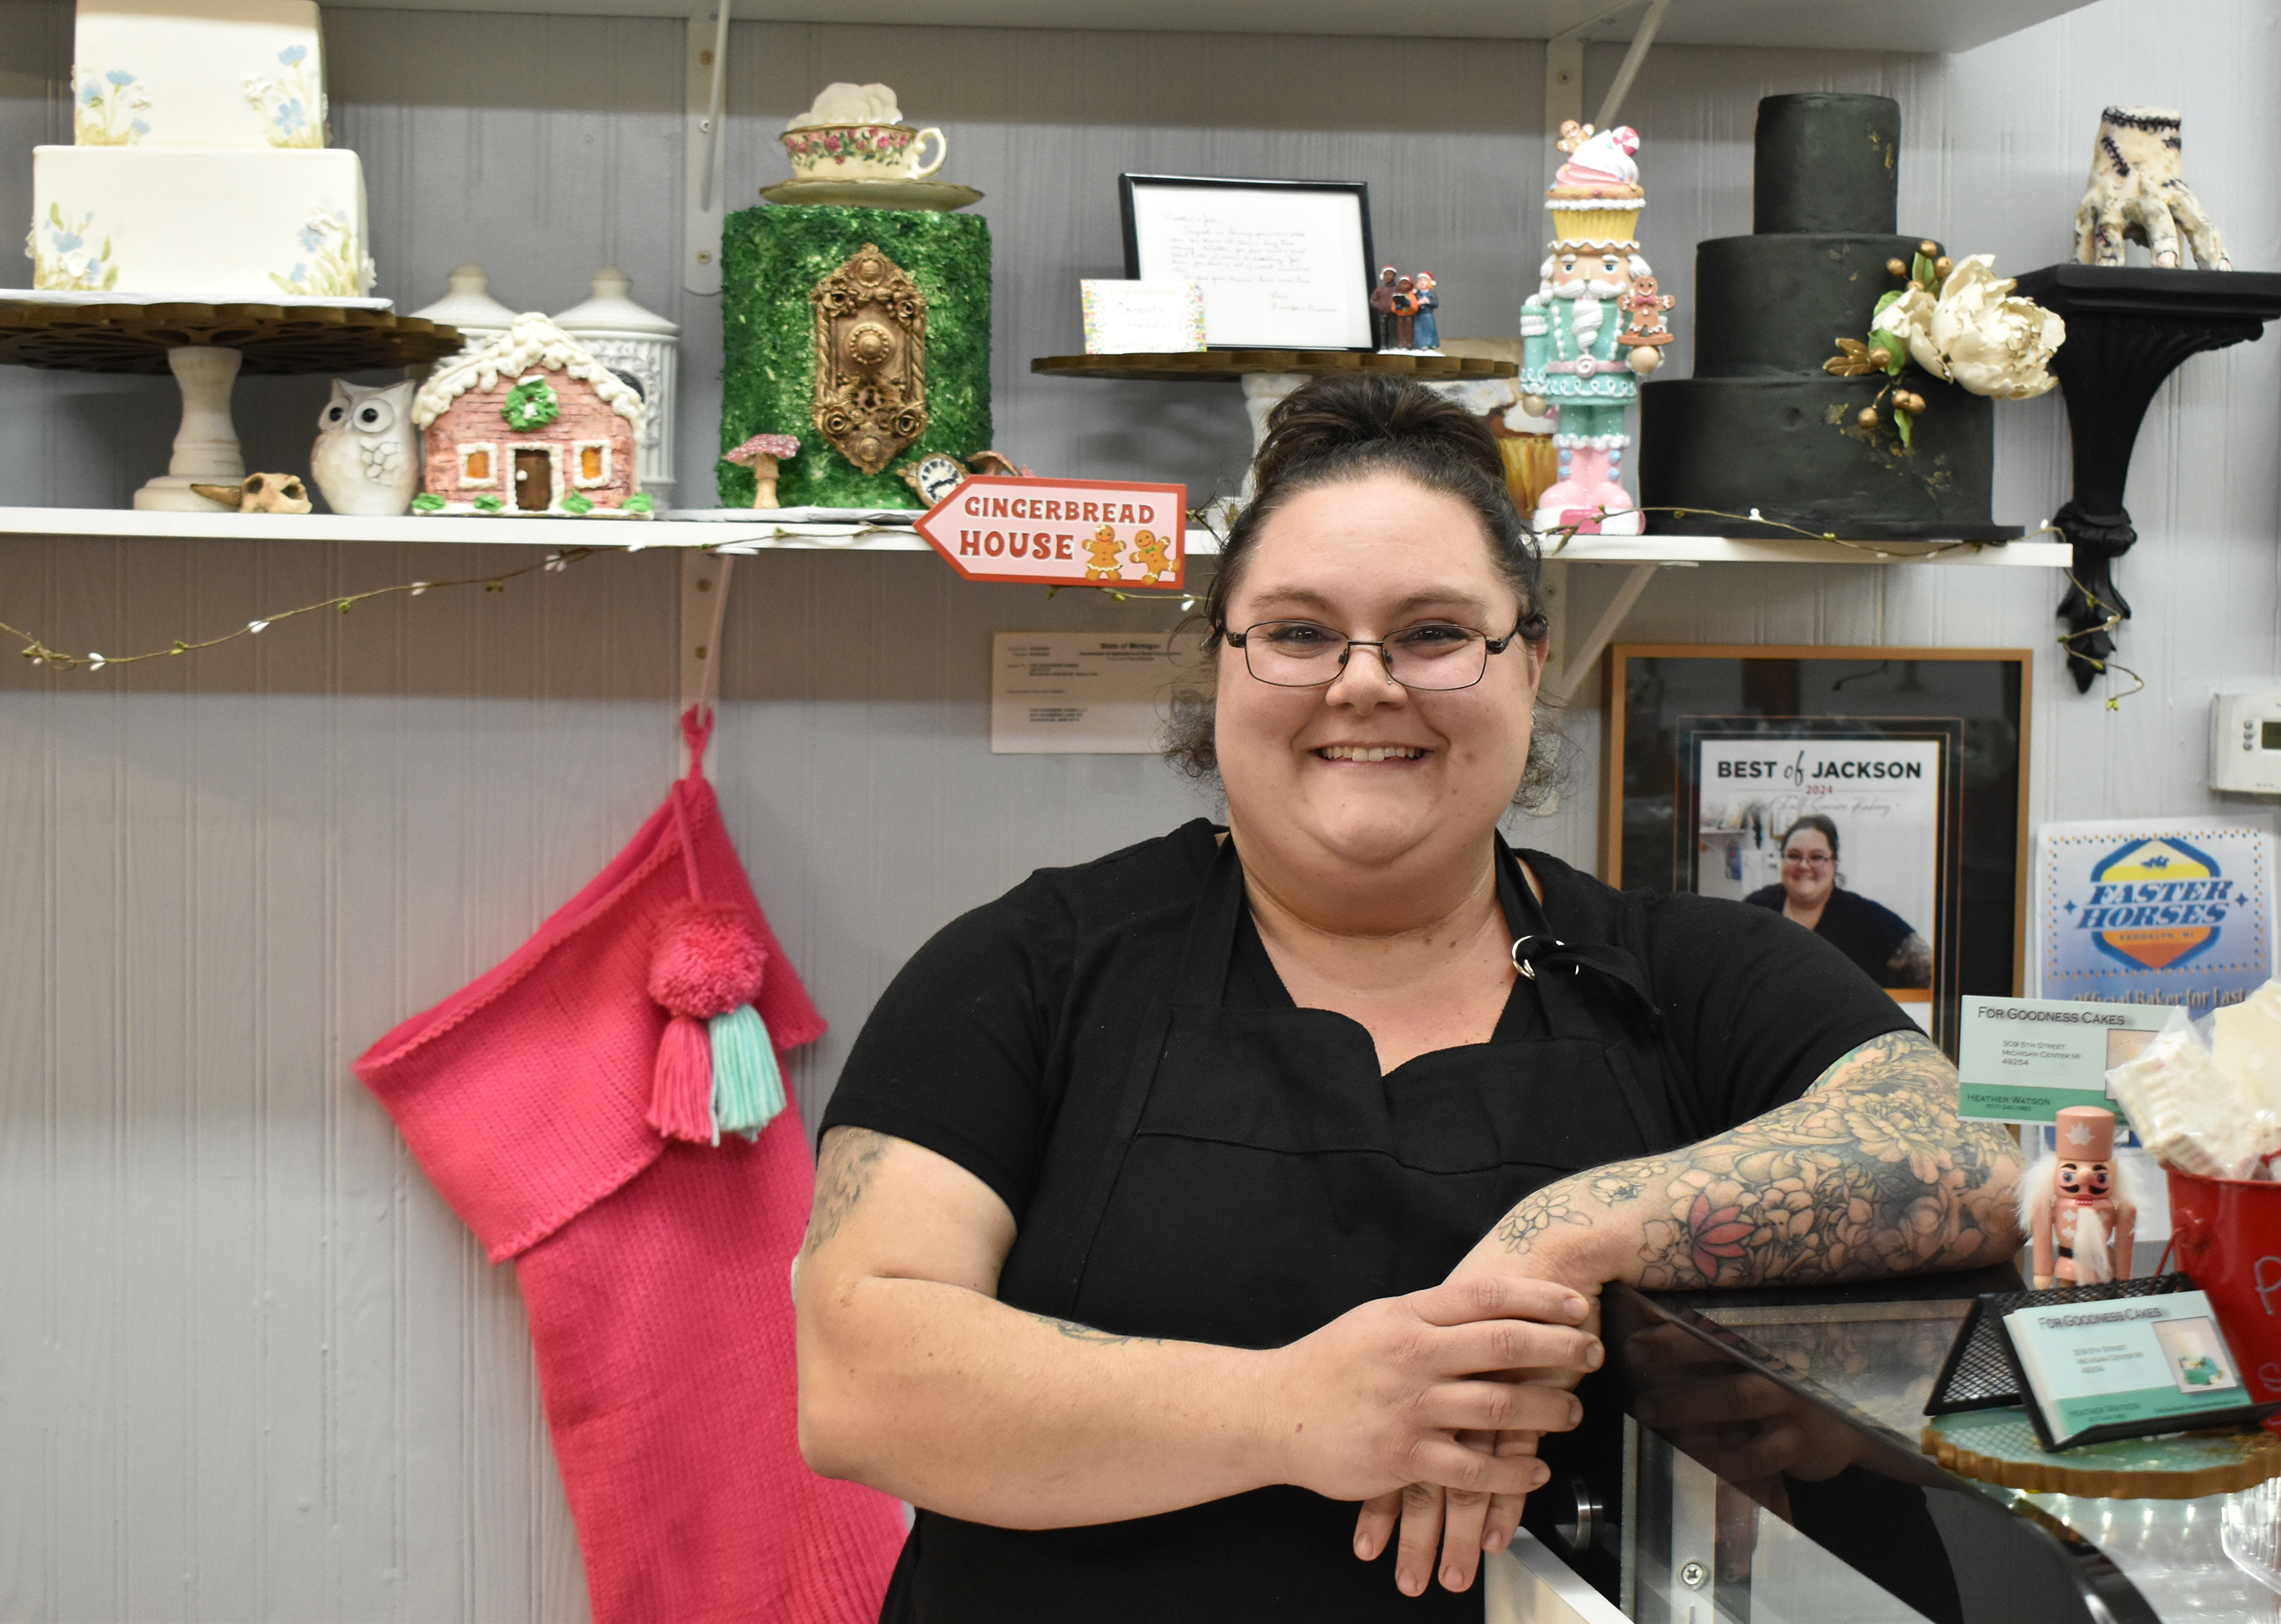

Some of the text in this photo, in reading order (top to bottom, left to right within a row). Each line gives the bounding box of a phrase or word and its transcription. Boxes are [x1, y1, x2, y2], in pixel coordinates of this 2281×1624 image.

[965, 495, 1155, 524] GINGERBREAD
[960, 529, 1074, 560] HOUSE
[1717, 749, 1922, 786] BEST of JACKSON
[1805, 785, 1834, 795] 2024
[2088, 880, 2234, 905] FASTER
[2076, 901, 2230, 929] HORSES
[2186, 986, 2211, 1009] for
[1978, 1006, 2125, 1026] FOR GOODNESS CAKES
[2002, 1040, 2019, 1048] 309
[2037, 1042, 2066, 1050] STREET
[2039, 1050, 2071, 1060] CENTER
[2001, 1057, 2029, 1066] 49254
[2011, 1096, 2051, 1106] WATSON
[2037, 1306, 2163, 1330] FOR GOODNESS CAKES
